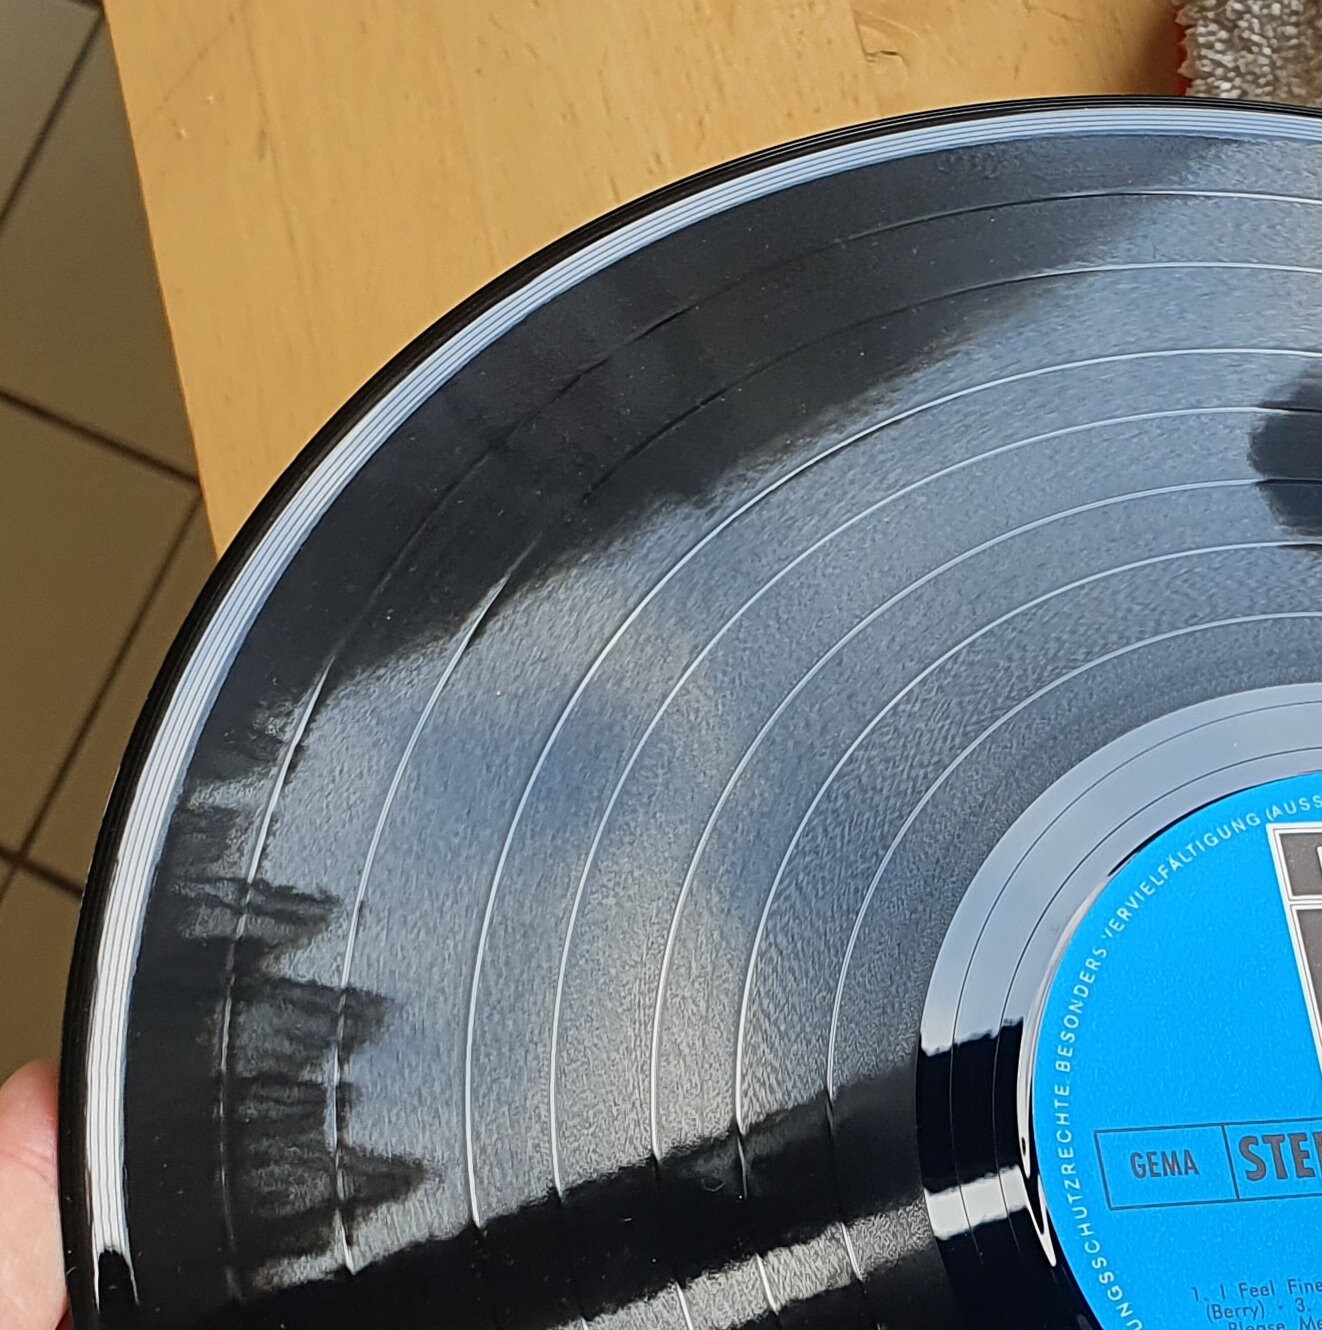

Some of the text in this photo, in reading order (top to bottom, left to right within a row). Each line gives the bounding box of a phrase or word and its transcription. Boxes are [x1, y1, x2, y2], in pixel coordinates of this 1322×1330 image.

[1055, 947, 1108, 1073] BESONDERS
[1130, 1149, 1200, 1180] GEMA
[1192, 1286, 1208, 1301] 1.
[1239, 1280, 1275, 1299] Feel
[1206, 1300, 1265, 1323] (Berry)
[1295, 1298, 1311, 1313] 3.
